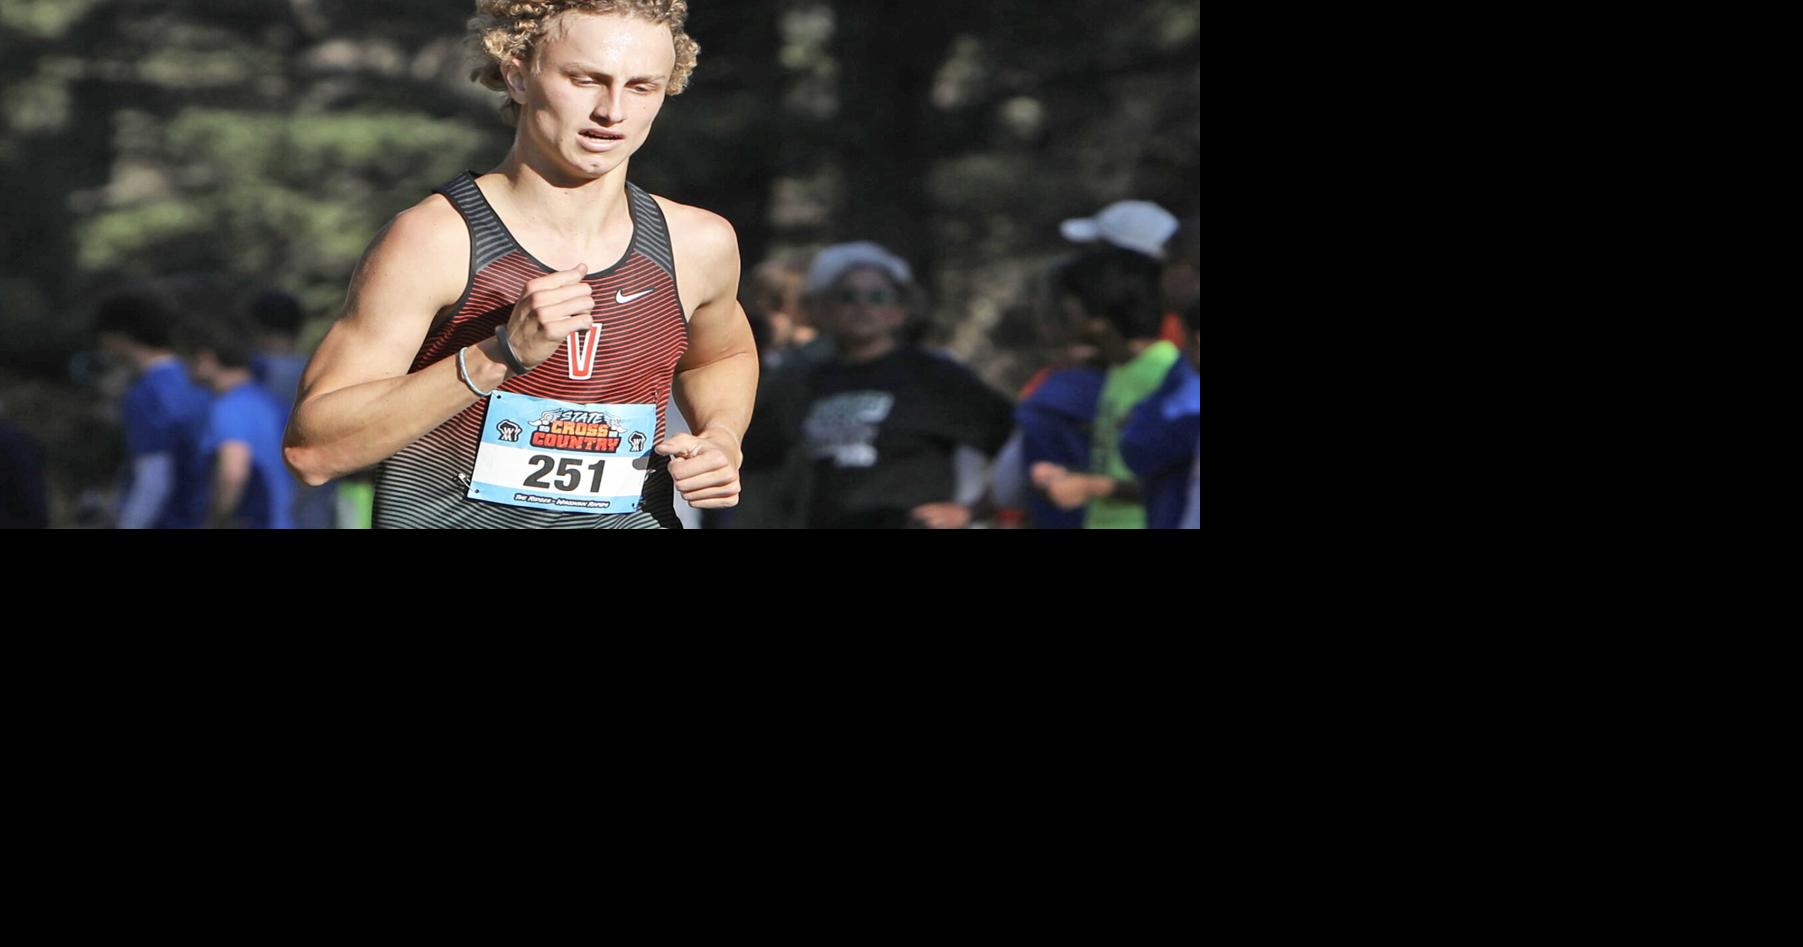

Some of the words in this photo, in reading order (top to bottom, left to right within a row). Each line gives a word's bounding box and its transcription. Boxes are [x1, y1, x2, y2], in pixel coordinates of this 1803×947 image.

[566, 323, 602, 380] V
[560, 410, 604, 424] STATE
[551, 420, 609, 438] CROSS
[532, 431, 620, 452] COUNTRY
[523, 454, 606, 493] 251
